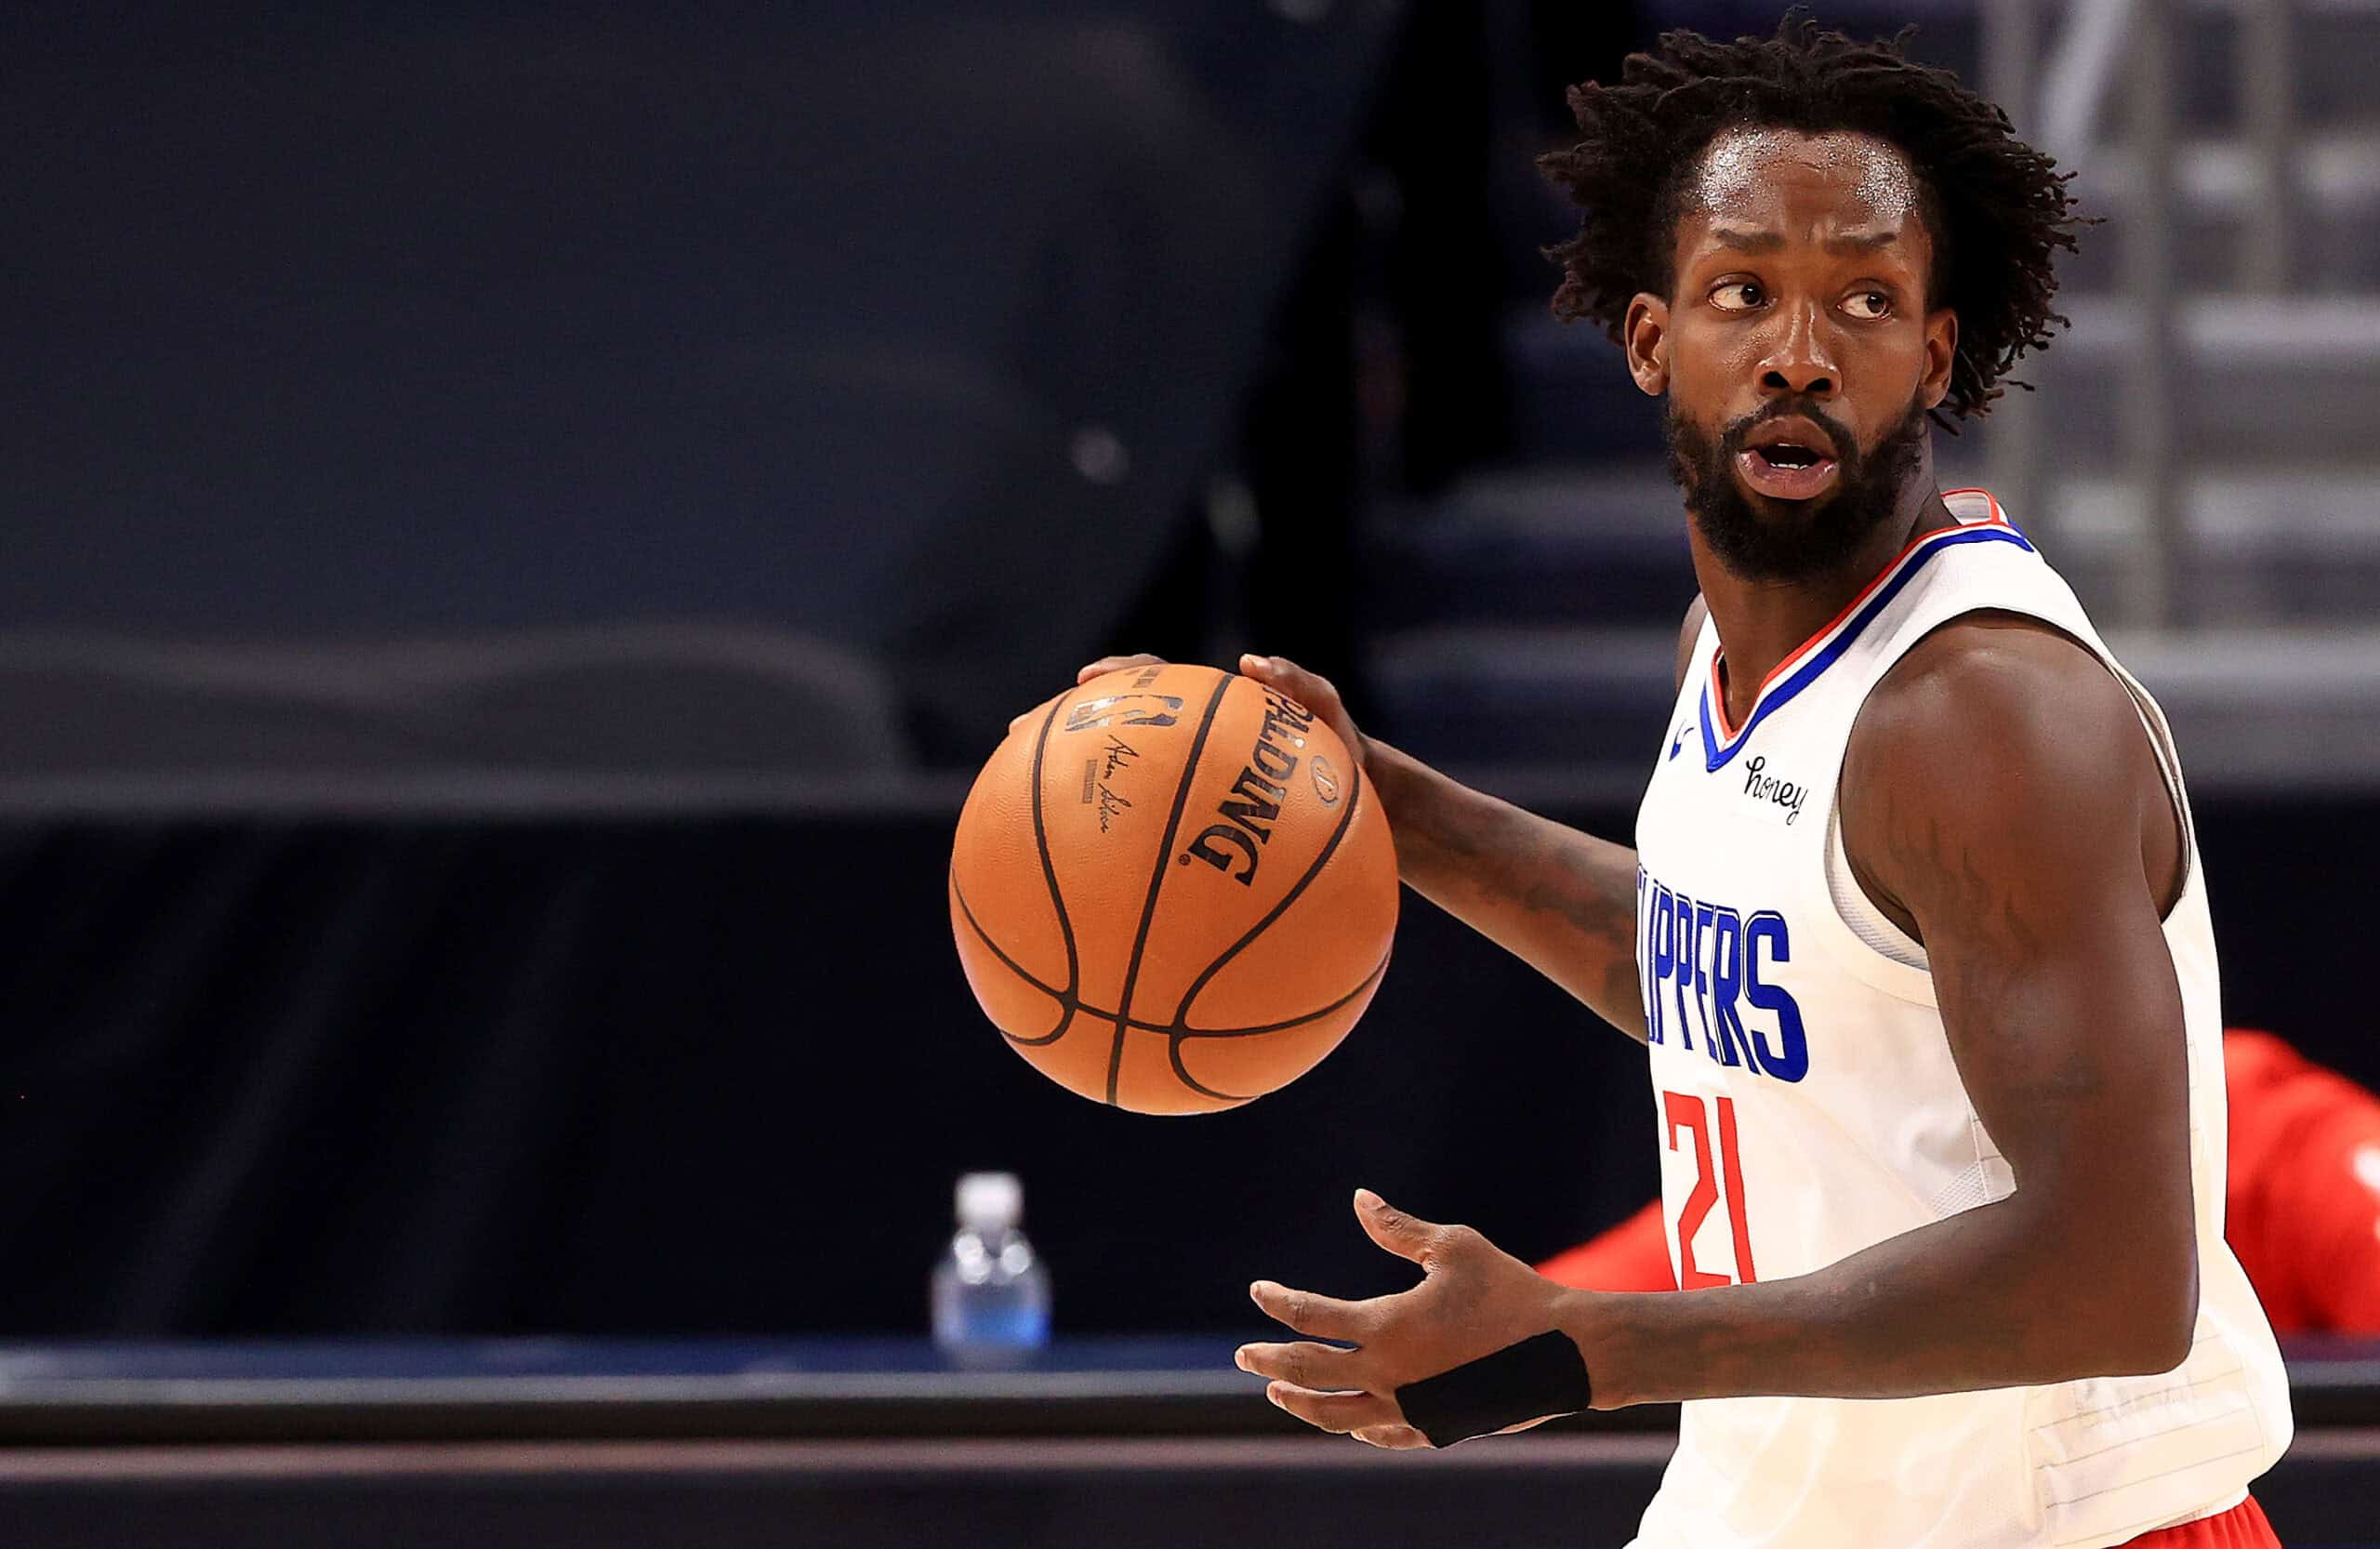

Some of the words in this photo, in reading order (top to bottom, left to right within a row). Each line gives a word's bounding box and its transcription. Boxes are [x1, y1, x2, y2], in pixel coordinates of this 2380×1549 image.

[1187, 685, 1316, 886] PALDING
[1744, 756, 1808, 826] honey
[1662, 1090, 1757, 1291] 21
